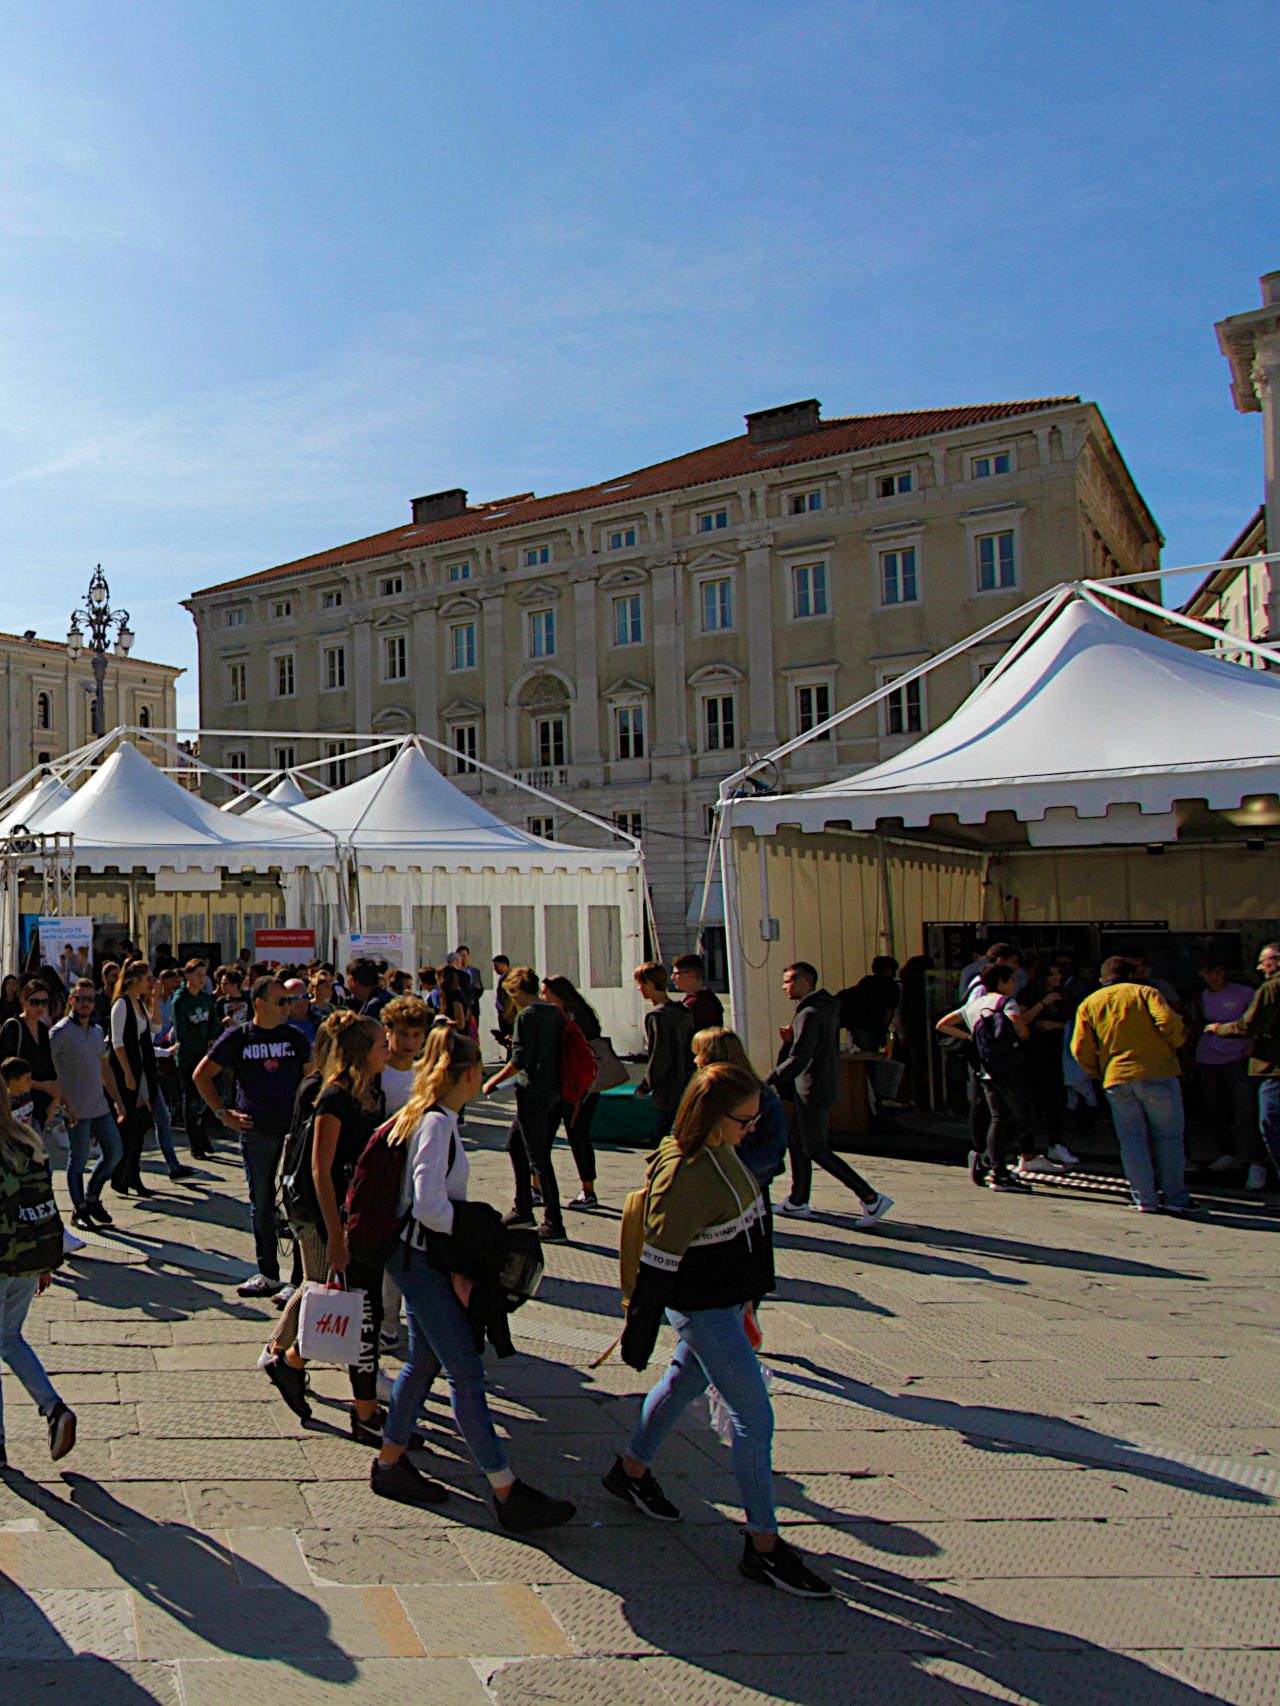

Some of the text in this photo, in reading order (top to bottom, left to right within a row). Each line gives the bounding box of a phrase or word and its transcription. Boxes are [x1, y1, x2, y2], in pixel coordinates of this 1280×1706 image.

[653, 1255, 678, 1267] TO STA
[315, 1312, 350, 1337] H&M
[358, 1341, 375, 1374] AIR
